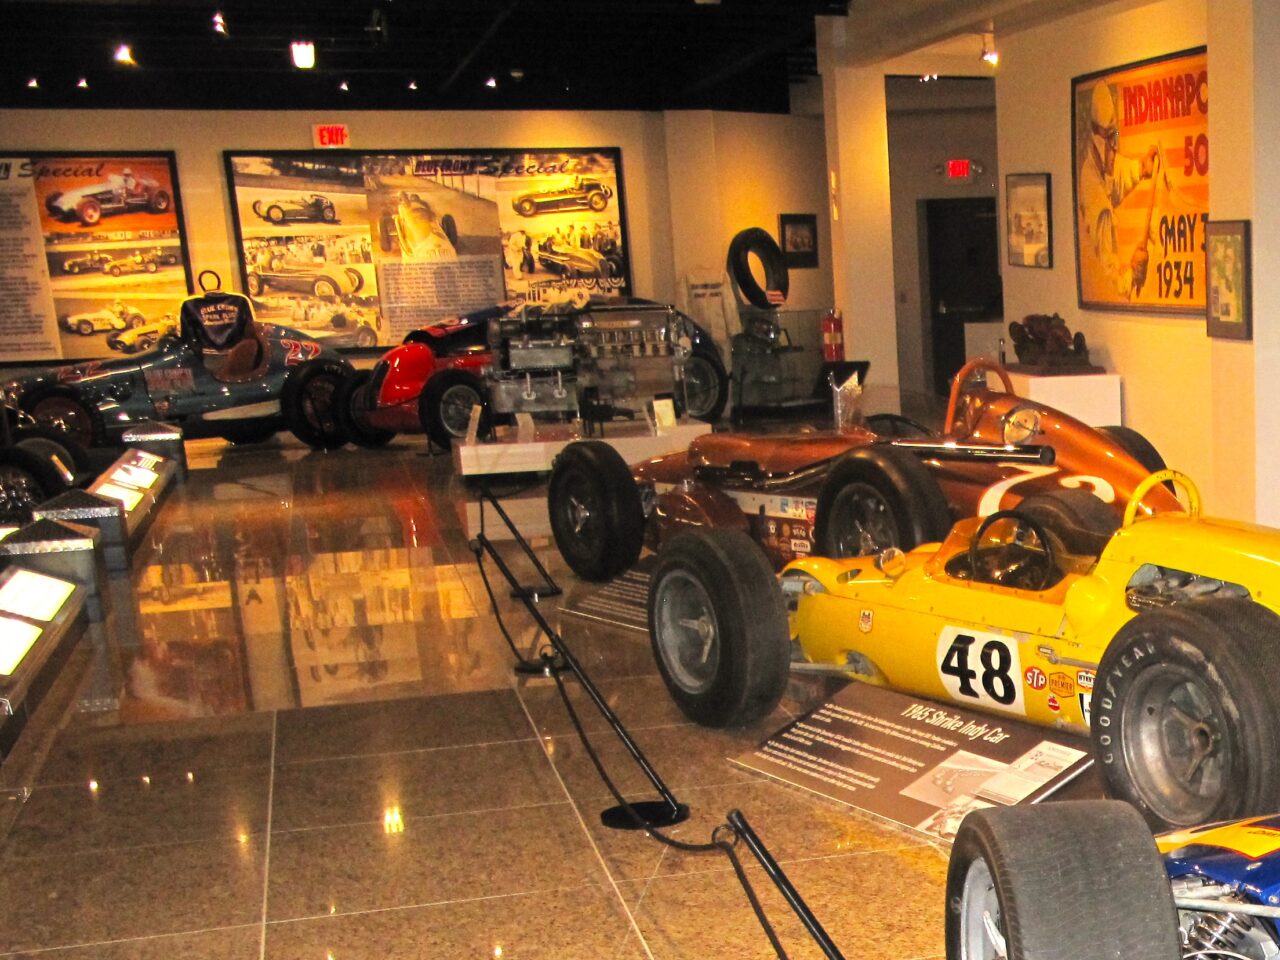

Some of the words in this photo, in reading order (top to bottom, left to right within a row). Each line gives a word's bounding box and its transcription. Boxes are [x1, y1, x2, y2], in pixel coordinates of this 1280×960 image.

[1159, 214, 1198, 258] MAY
[1156, 261, 1195, 299] 1934
[940, 634, 1017, 706] 48
[1026, 668, 1046, 688] STP
[901, 703, 931, 722] 1965
[930, 710, 963, 733] Shrike
[961, 721, 989, 743] Indy
[981, 727, 1010, 746] Car
